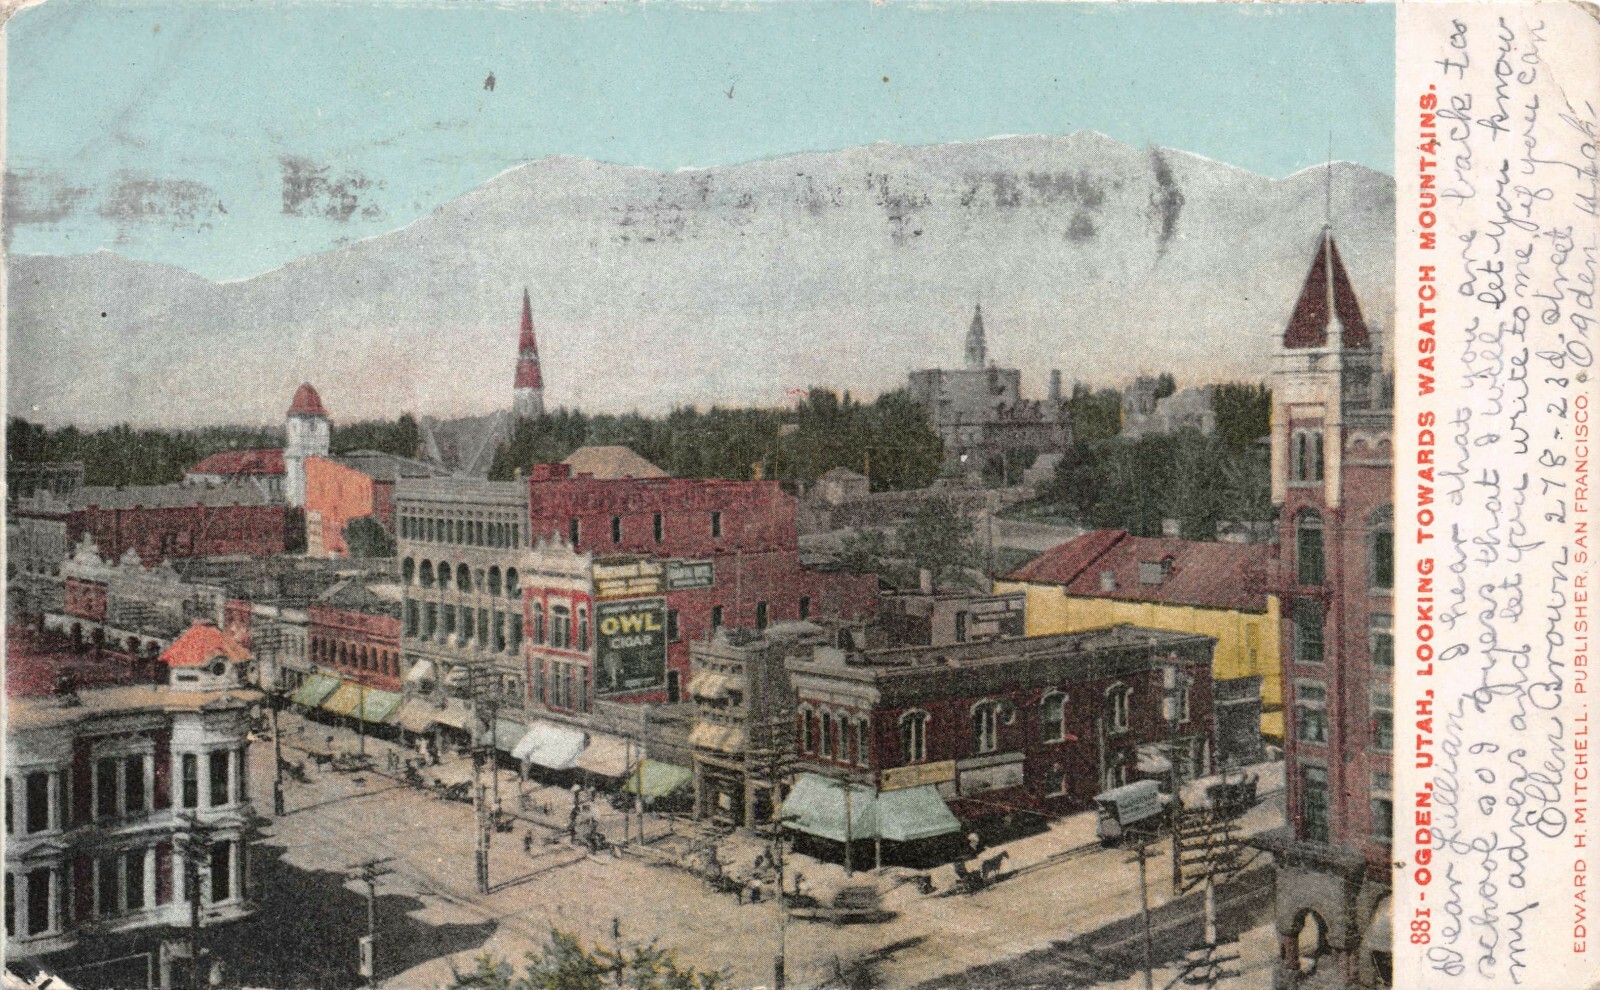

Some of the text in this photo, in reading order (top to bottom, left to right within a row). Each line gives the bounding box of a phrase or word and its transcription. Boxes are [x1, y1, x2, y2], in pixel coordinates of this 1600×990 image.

[1477, 17, 1514, 141] know
[1419, 84, 1437, 249] MOUNTAINS.
[1436, 94, 1475, 206] back
[1520, 95, 1561, 174] you
[1485, 160, 1539, 254] you
[1513, 186, 1553, 217] if
[1458, 230, 1477, 296] are
[1476, 261, 1506, 309] let
[1418, 266, 1436, 396] WASATCH
[1460, 317, 1493, 388] you
[1479, 322, 1504, 415] will
[1503, 307, 1529, 342] to
[1474, 434, 1500, 447] I
[1508, 348, 1528, 454] write
[1417, 411, 1435, 543] TOWARDS
[1438, 407, 1471, 505] that
[1575, 391, 1588, 512] FRANCISCO.
[1473, 469, 1501, 567] that
[1507, 473, 1545, 562] you
[1574, 522, 1587, 563] SAN
[1417, 558, 1433, 676] LOOKING
[1439, 523, 1467, 630] hear
[1498, 573, 1523, 623] let
[601, 612, 661, 635] OWL
[609, 635, 653, 649] CIGAR
[1438, 644, 1469, 661] I
[1462, 584, 1520, 713] guess
[1416, 689, 1433, 768] UTAH,
[1490, 644, 1530, 731] and
[1525, 717, 1566, 838] Ellen
[1426, 863, 1465, 976] Dear
[1469, 832, 1499, 979] school
[1506, 902, 1539, 984] my
[1574, 860, 1586, 953] EDWARD
